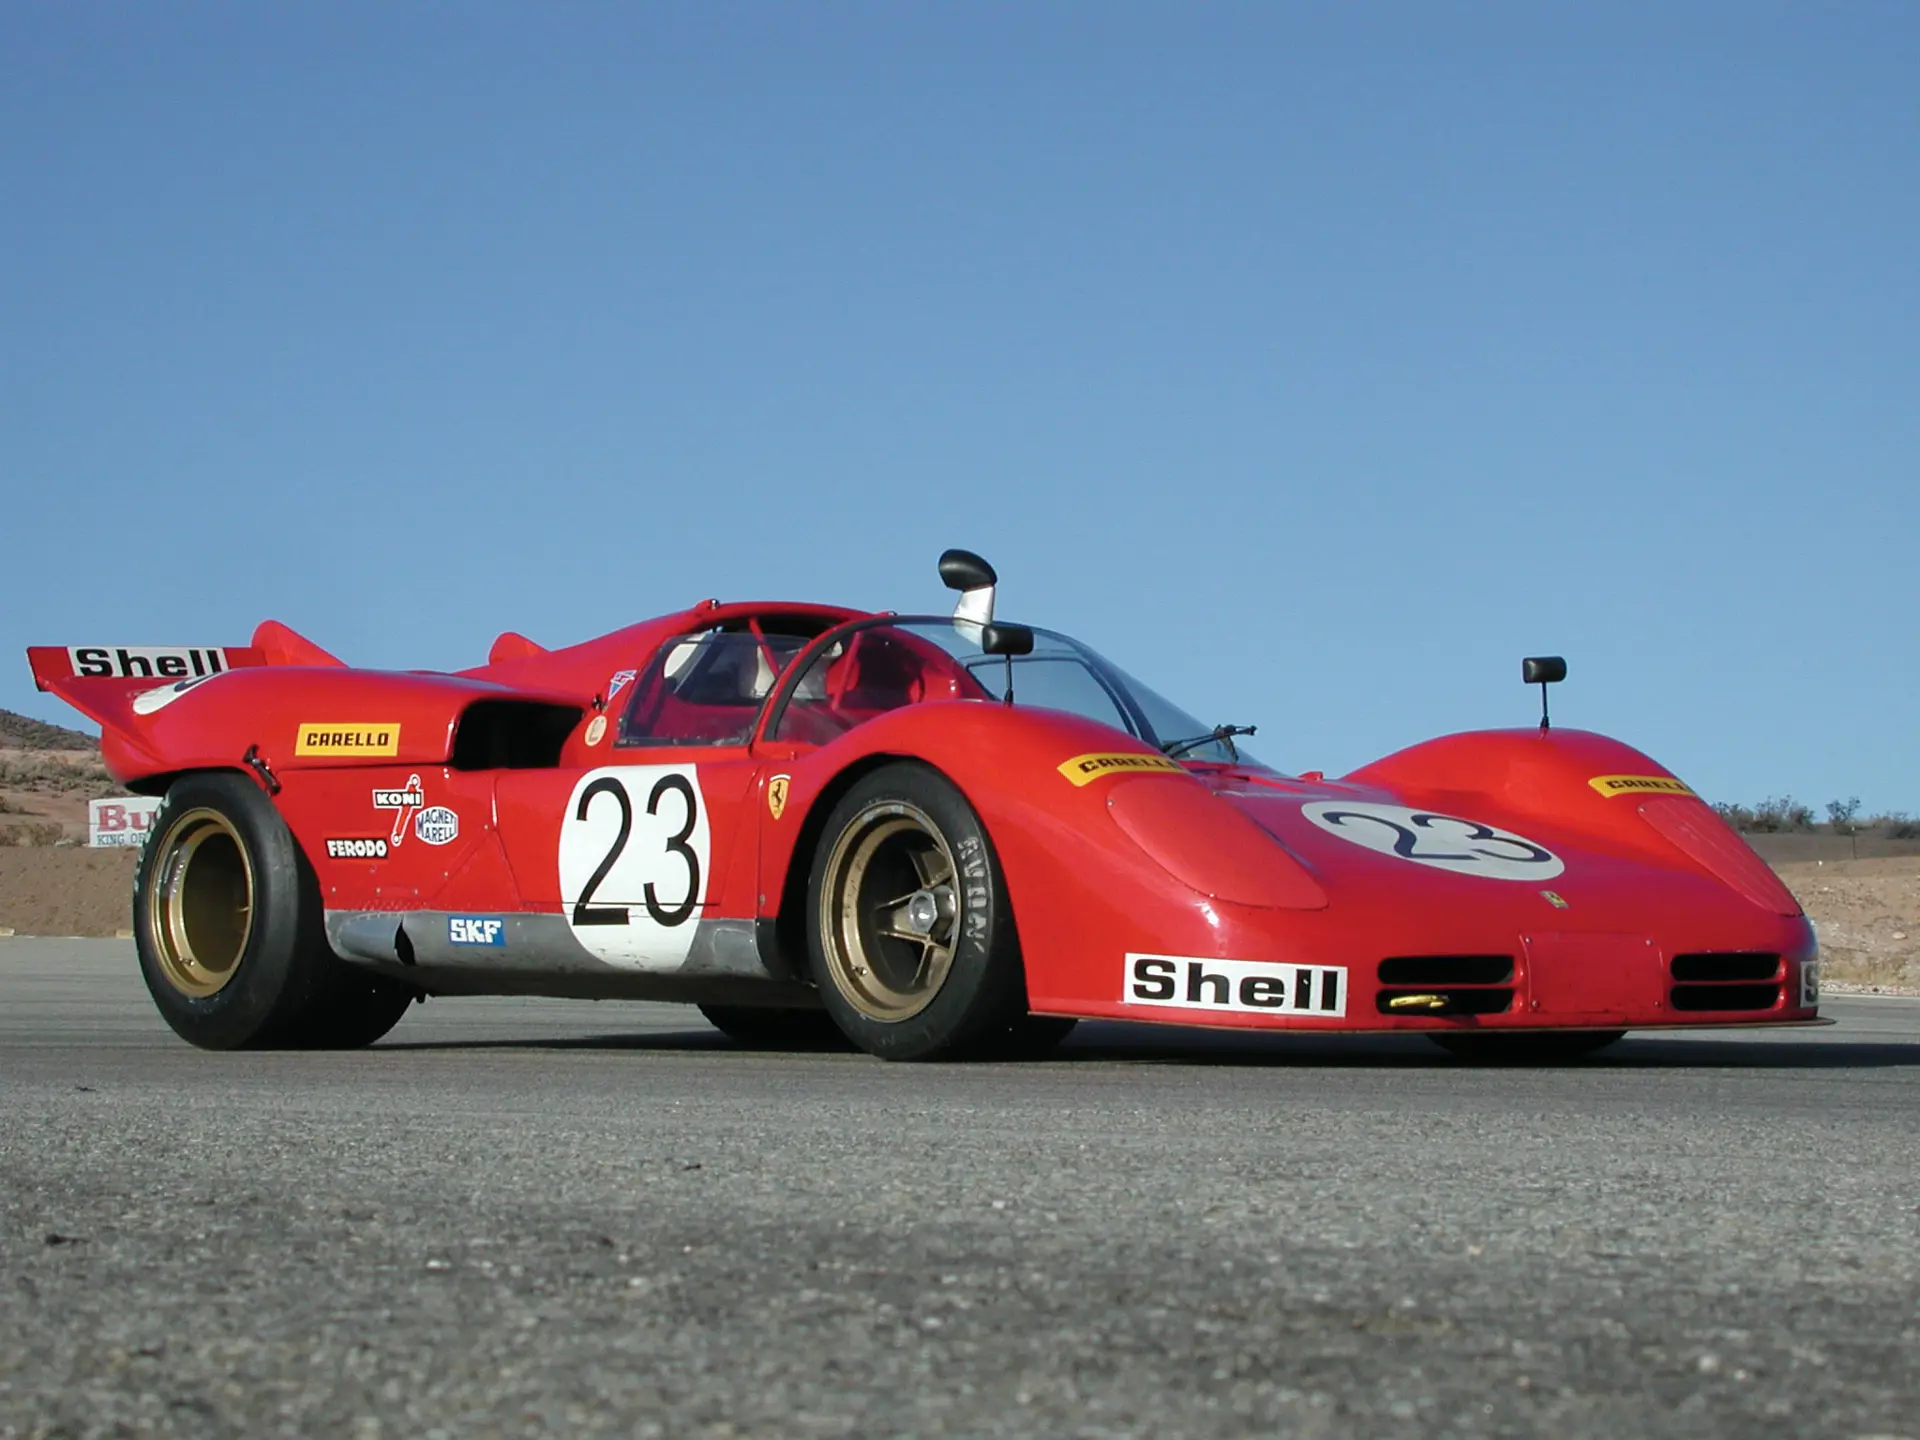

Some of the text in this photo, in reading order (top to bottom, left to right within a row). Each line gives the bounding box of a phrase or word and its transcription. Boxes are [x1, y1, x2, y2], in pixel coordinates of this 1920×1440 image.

[75, 649, 222, 677] Shell
[306, 732, 389, 747] CARELLO
[1605, 779, 1685, 790] CARELL
[375, 793, 421, 805] KONI
[97, 834, 124, 845] KING
[1322, 811, 1552, 862] 23
[327, 840, 387, 857] FERODO
[572, 773, 700, 927] 23
[450, 919, 502, 943] SKF
[1132, 958, 1339, 1011] Shell
